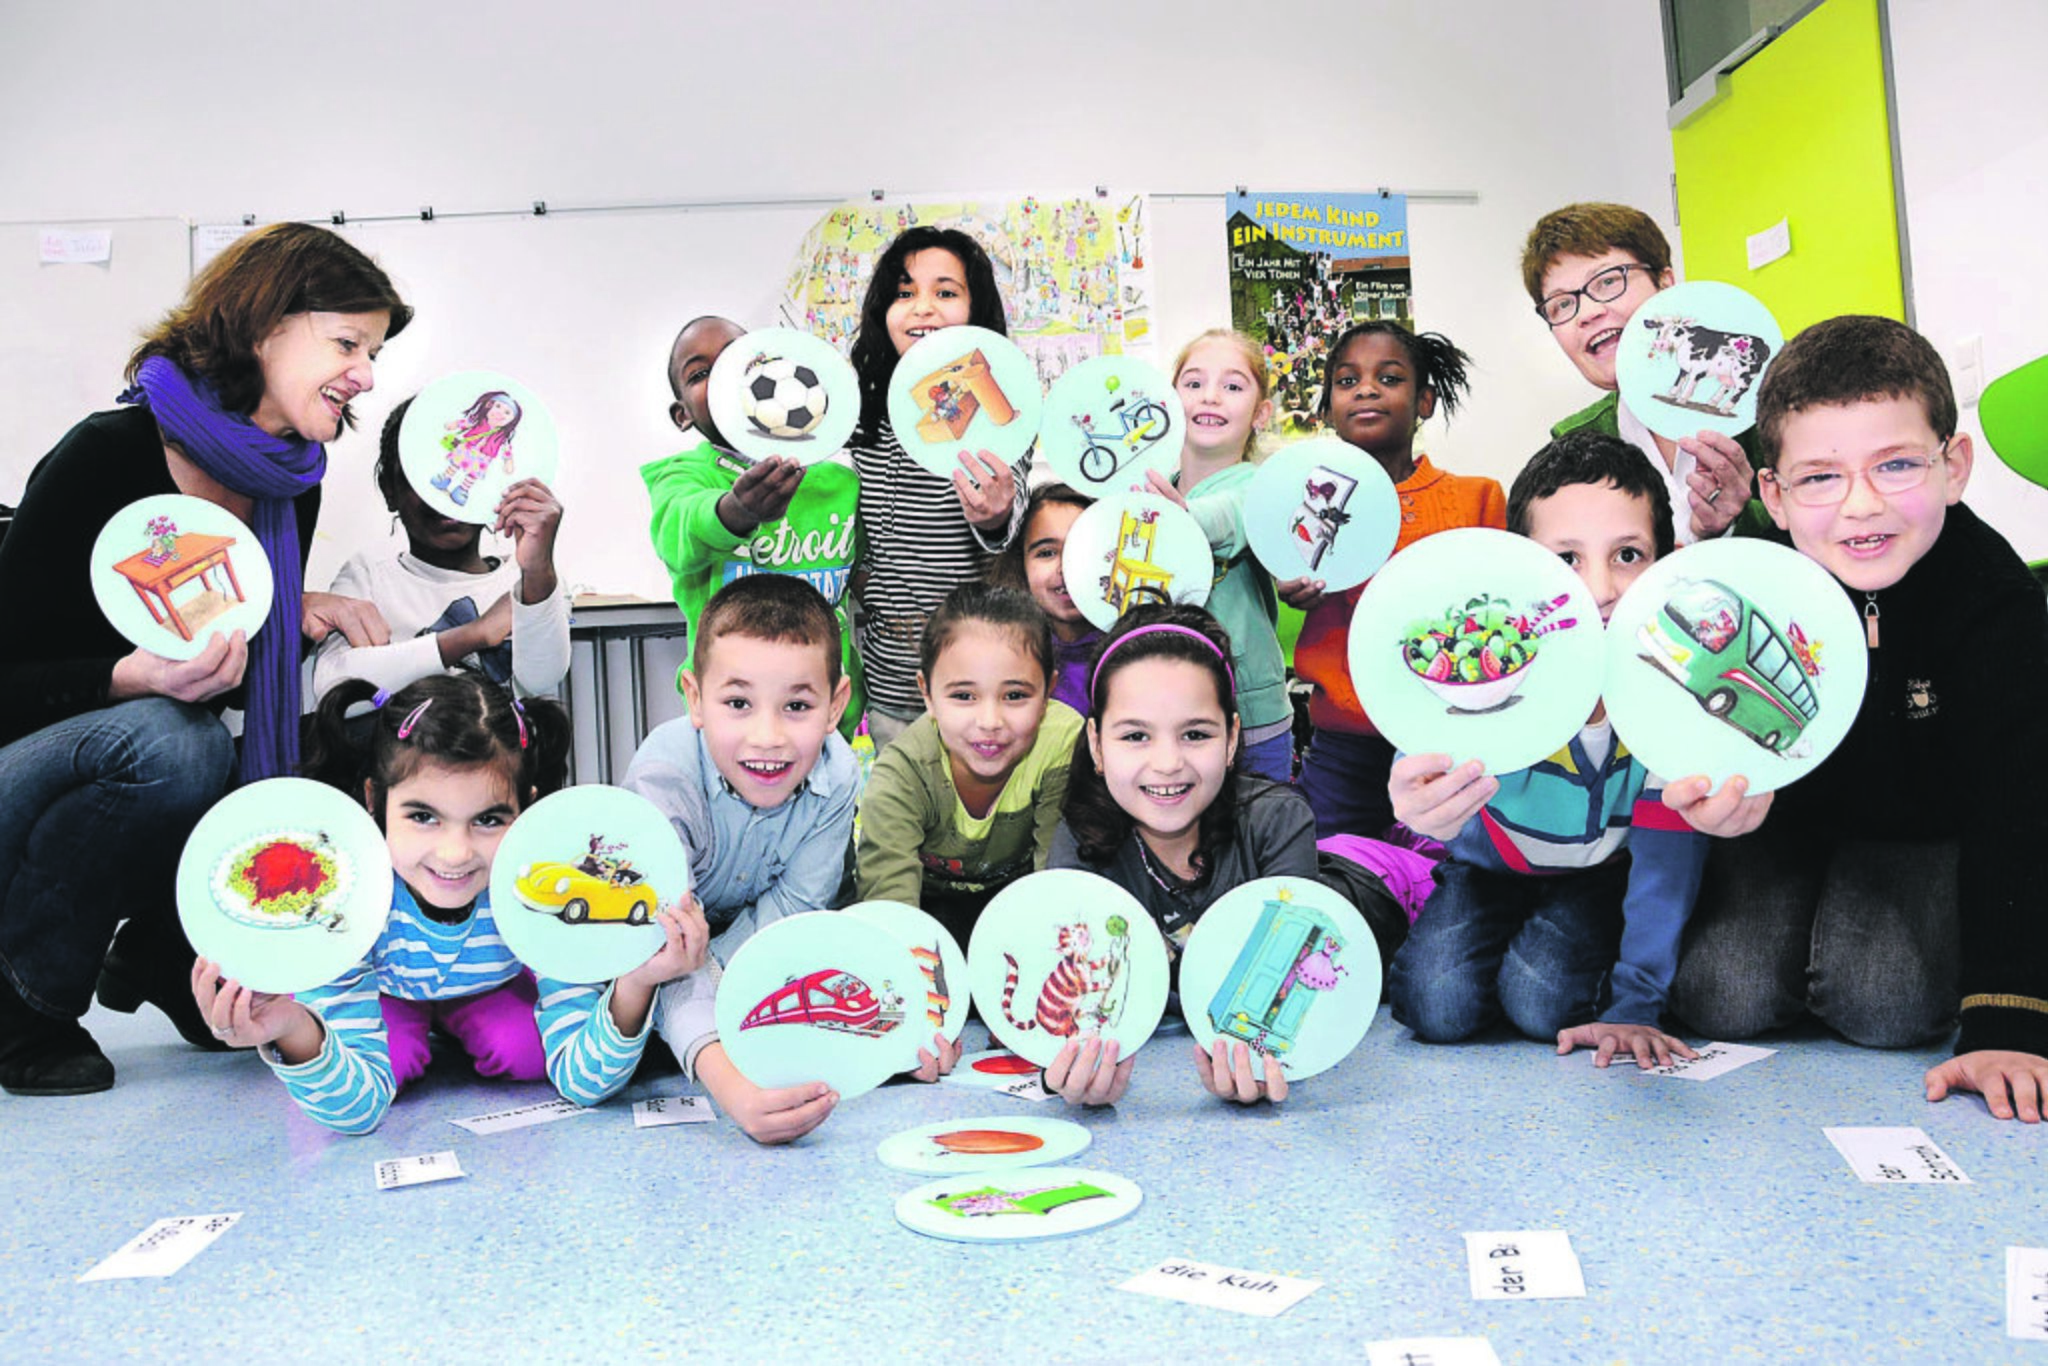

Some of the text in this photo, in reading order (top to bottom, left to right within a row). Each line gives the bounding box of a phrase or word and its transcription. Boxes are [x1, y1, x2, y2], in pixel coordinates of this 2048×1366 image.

[1255, 201, 1380, 228] JEDEM KIND
[1233, 222, 1405, 249] EIN INSTRUMENT
[734, 513, 856, 566] etroit
[1160, 1264, 1279, 1293] die Kuh
[1491, 1265, 1526, 1295] der
